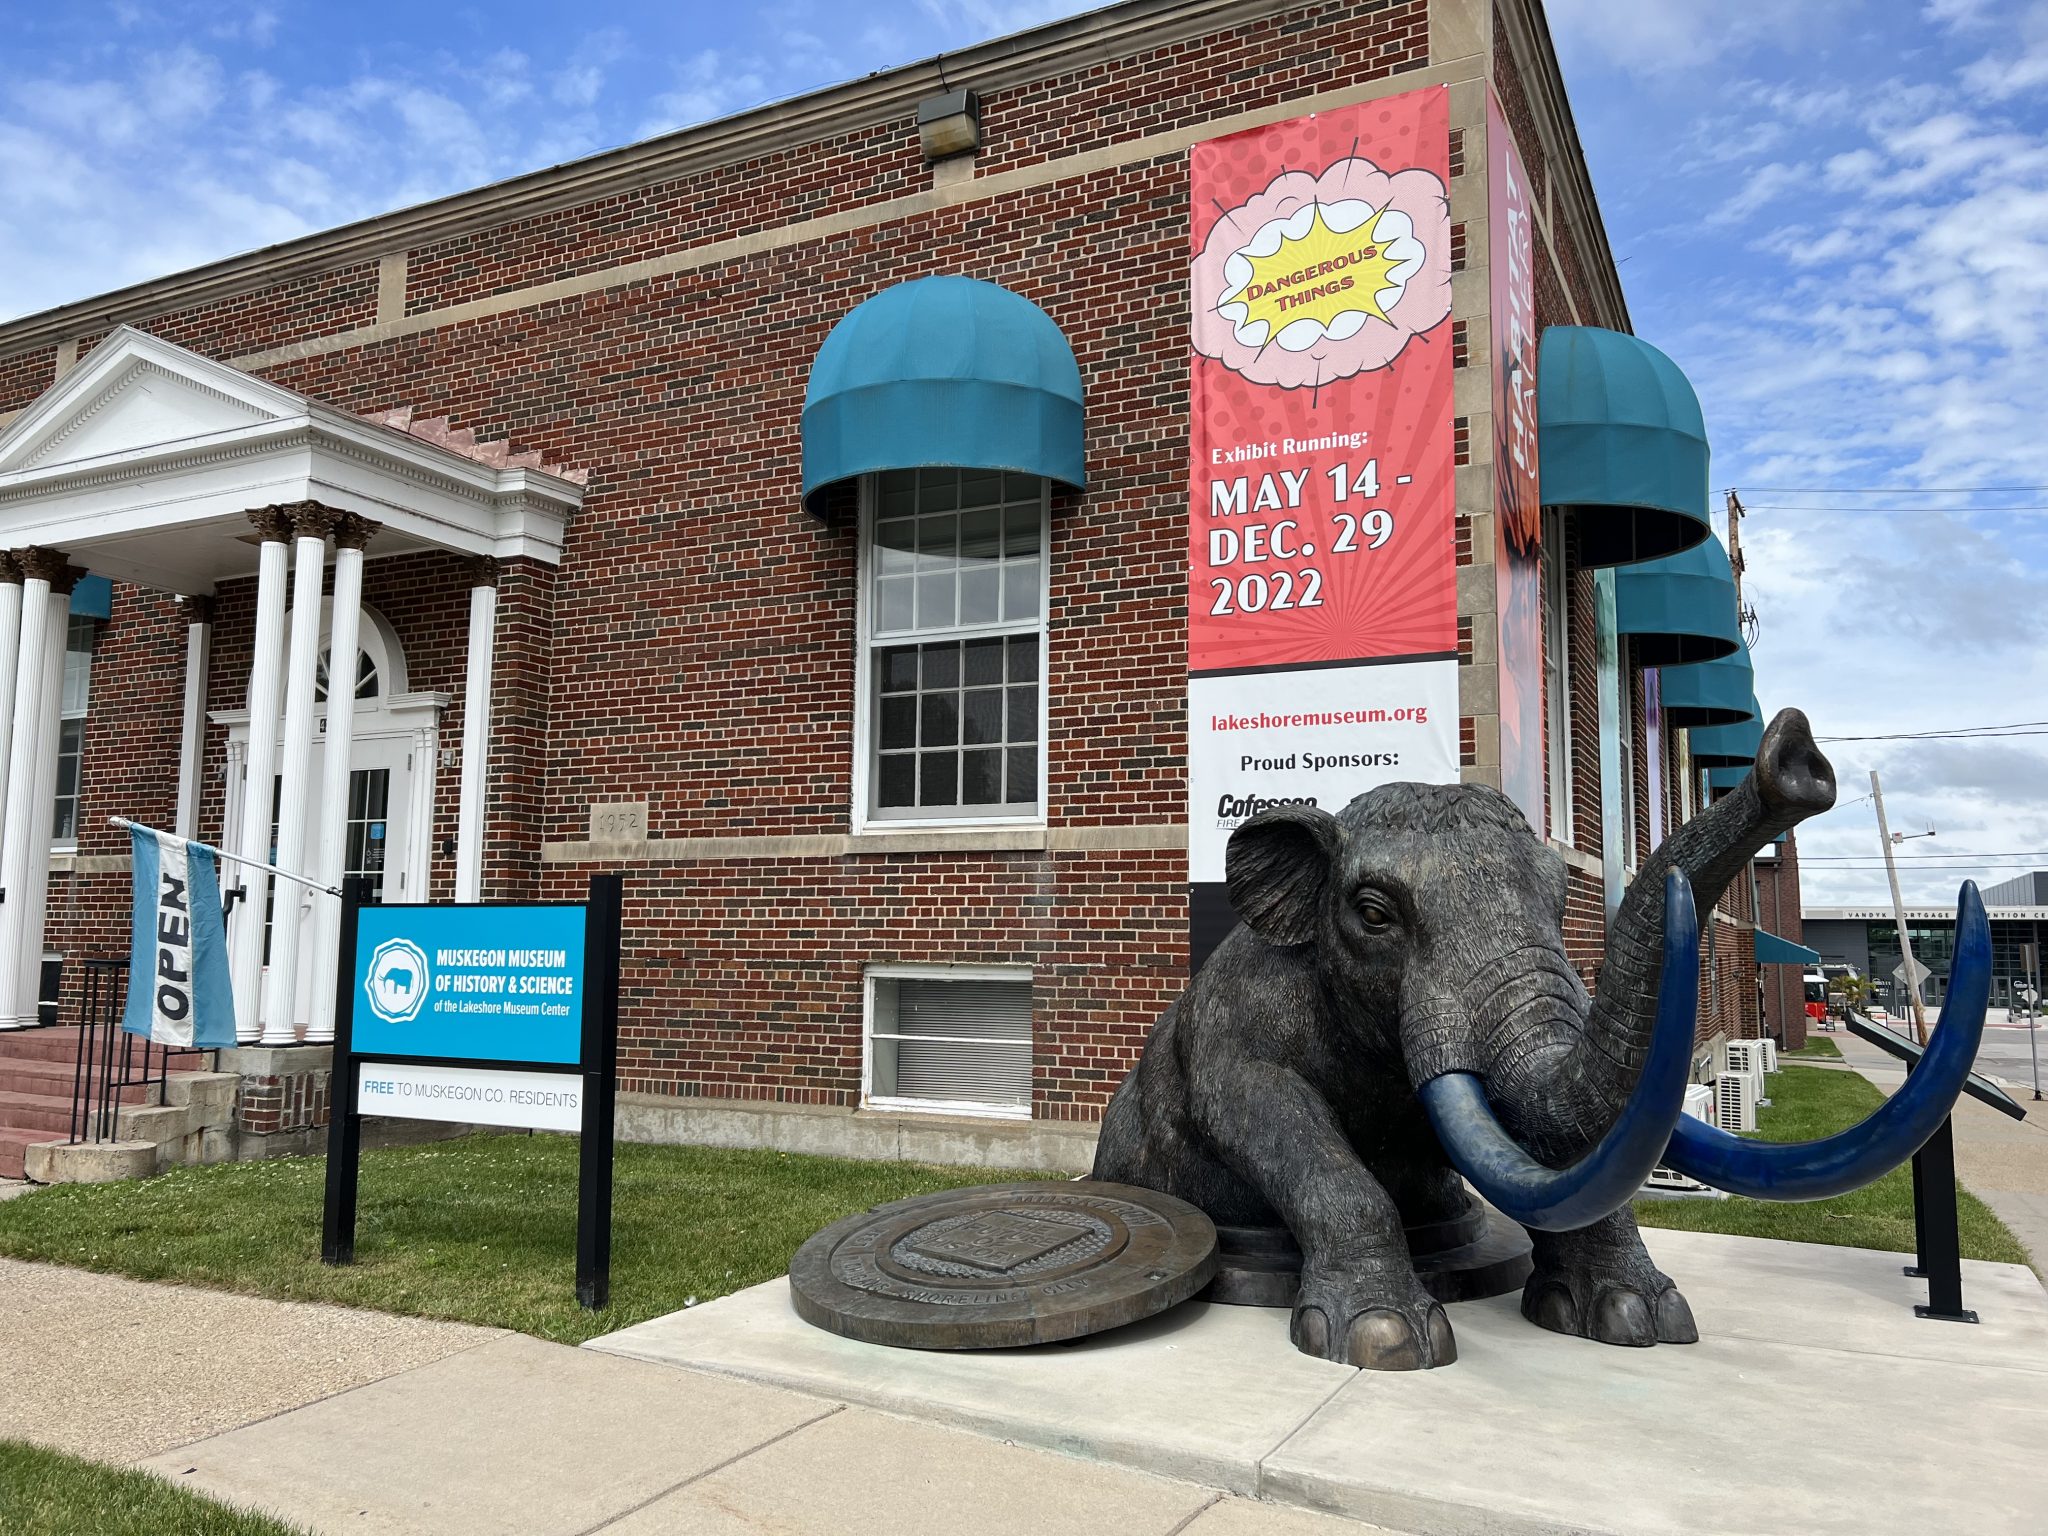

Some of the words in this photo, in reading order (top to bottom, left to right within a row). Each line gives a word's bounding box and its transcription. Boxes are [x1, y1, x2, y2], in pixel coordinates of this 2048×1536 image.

[1246, 245, 1378, 301] DANGEROUS
[1274, 275, 1355, 312] THINGS
[1506, 150, 1524, 470] HABITAT
[1517, 182, 1536, 480] GALLERY
[1212, 441, 1277, 464] Exhibit
[1283, 431, 1368, 455] Running:
[1211, 467, 1311, 517] MAY
[1326, 458, 1380, 502] 14
[1209, 520, 1315, 567] DEC.
[1331, 508, 1394, 554] 29
[1210, 567, 1324, 616] 2022
[1212, 706, 1428, 731] lakeshoremuseum.org
[1241, 753, 1296, 771] Proud
[1302, 752, 1399, 771] Sponsors:
[600, 813, 638, 832] 1952
[1216, 819, 1240, 828] FIRE
[157, 872, 190, 1020] OPEN
[436, 949, 506, 968] MUSKEGON
[508, 950, 566, 968] MUSEUM
[435, 974, 451, 992] OF
[453, 975, 507, 993] HISTORY
[508, 977, 518, 993] &
[519, 976, 573, 995] SCIENCE
[434, 1000, 443, 1013] of
[443, 1000, 457, 1013] the
[459, 1001, 501, 1014] Lakeshore
[503, 1002, 539, 1015] Museum
[541, 1003, 570, 1016] Center
[364, 1080, 394, 1095] FREE
[397, 1082, 412, 1096] TO
[415, 1084, 482, 1101] MUSKEGON
[484, 1088, 506, 1103] CO.
[509, 1090, 578, 1108] RESIDENTS
[1042, 1279, 1088, 1296] CITY
